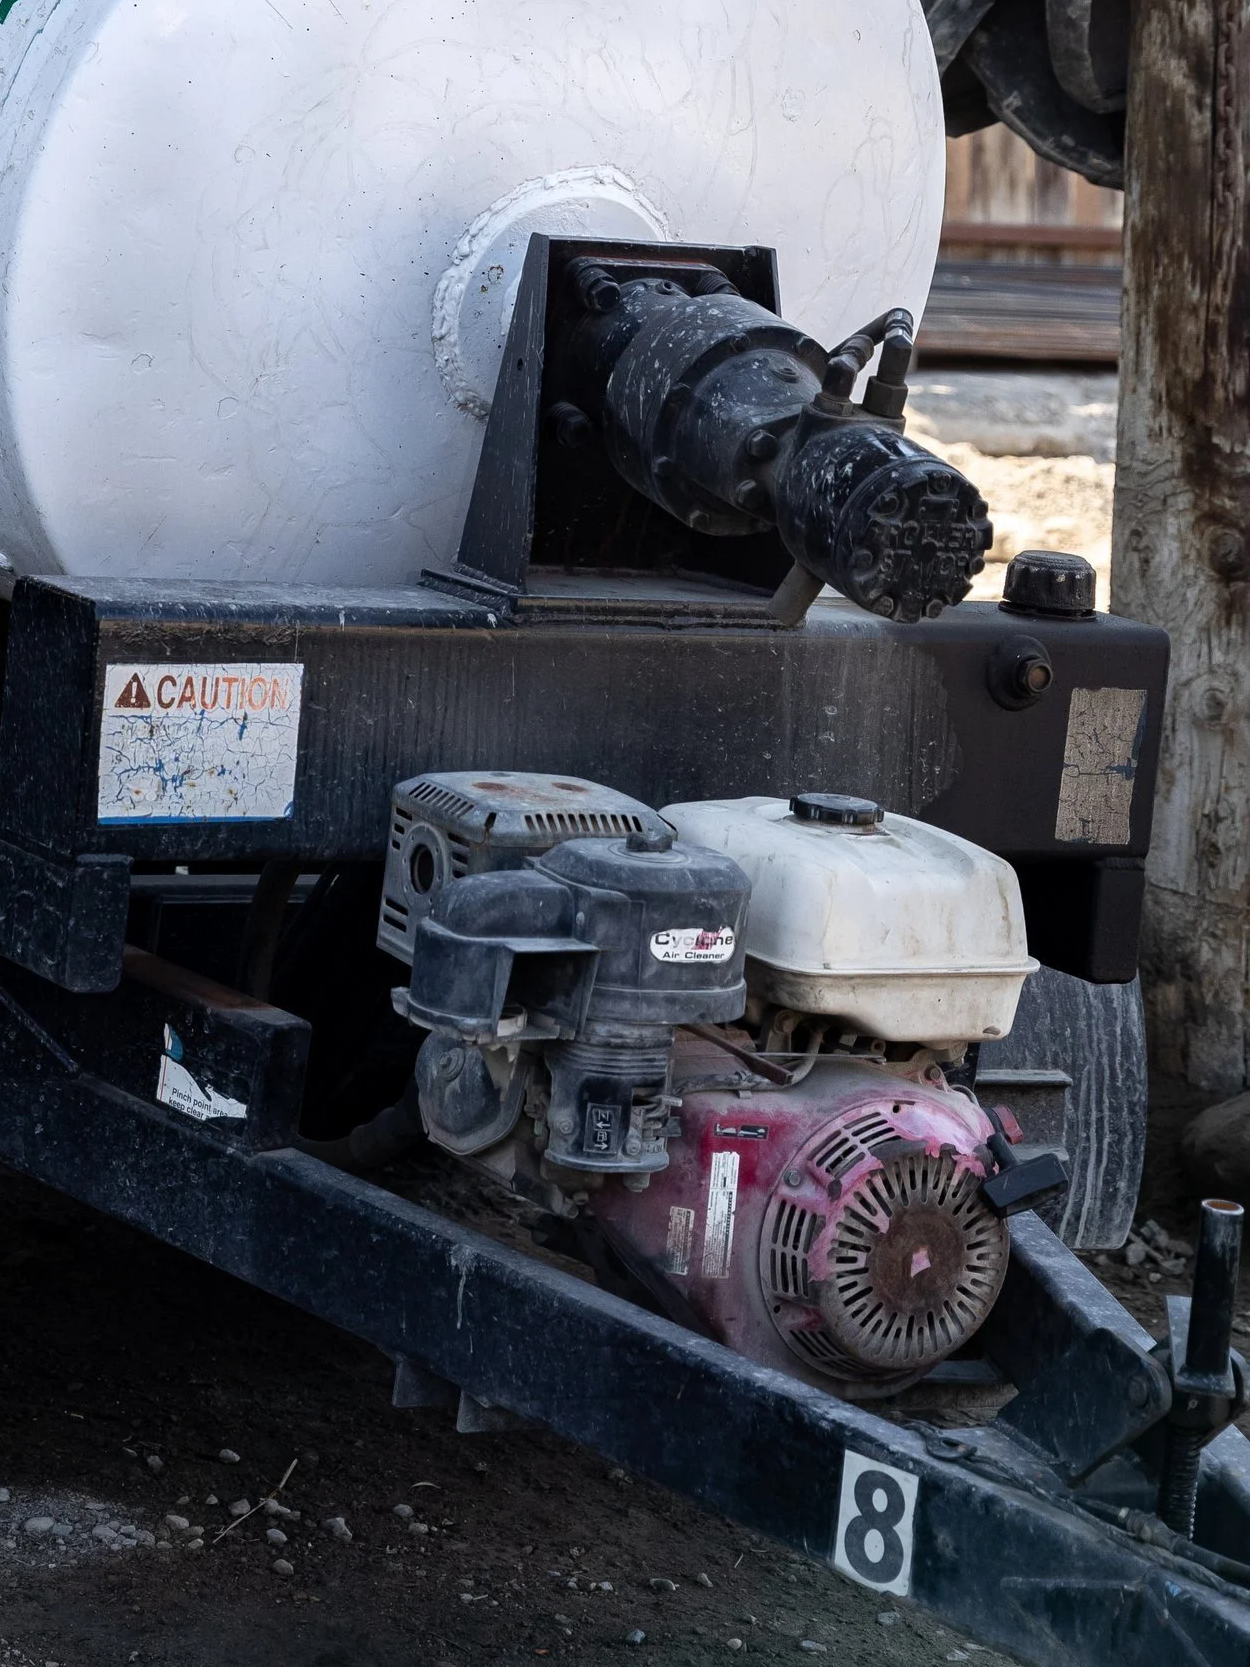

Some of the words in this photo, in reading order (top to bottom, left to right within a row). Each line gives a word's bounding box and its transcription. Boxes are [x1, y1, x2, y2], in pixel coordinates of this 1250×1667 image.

[157, 675, 289, 710] CAUTION
[662, 951, 680, 959] Air
[684, 951, 725, 959] Cleaner
[168, 1097, 186, 1111] keep
[186, 1105, 204, 1119] clear
[171, 1087, 192, 1103] Pinch
[193, 1098, 212, 1112] point
[844, 1470, 905, 1583] 8
